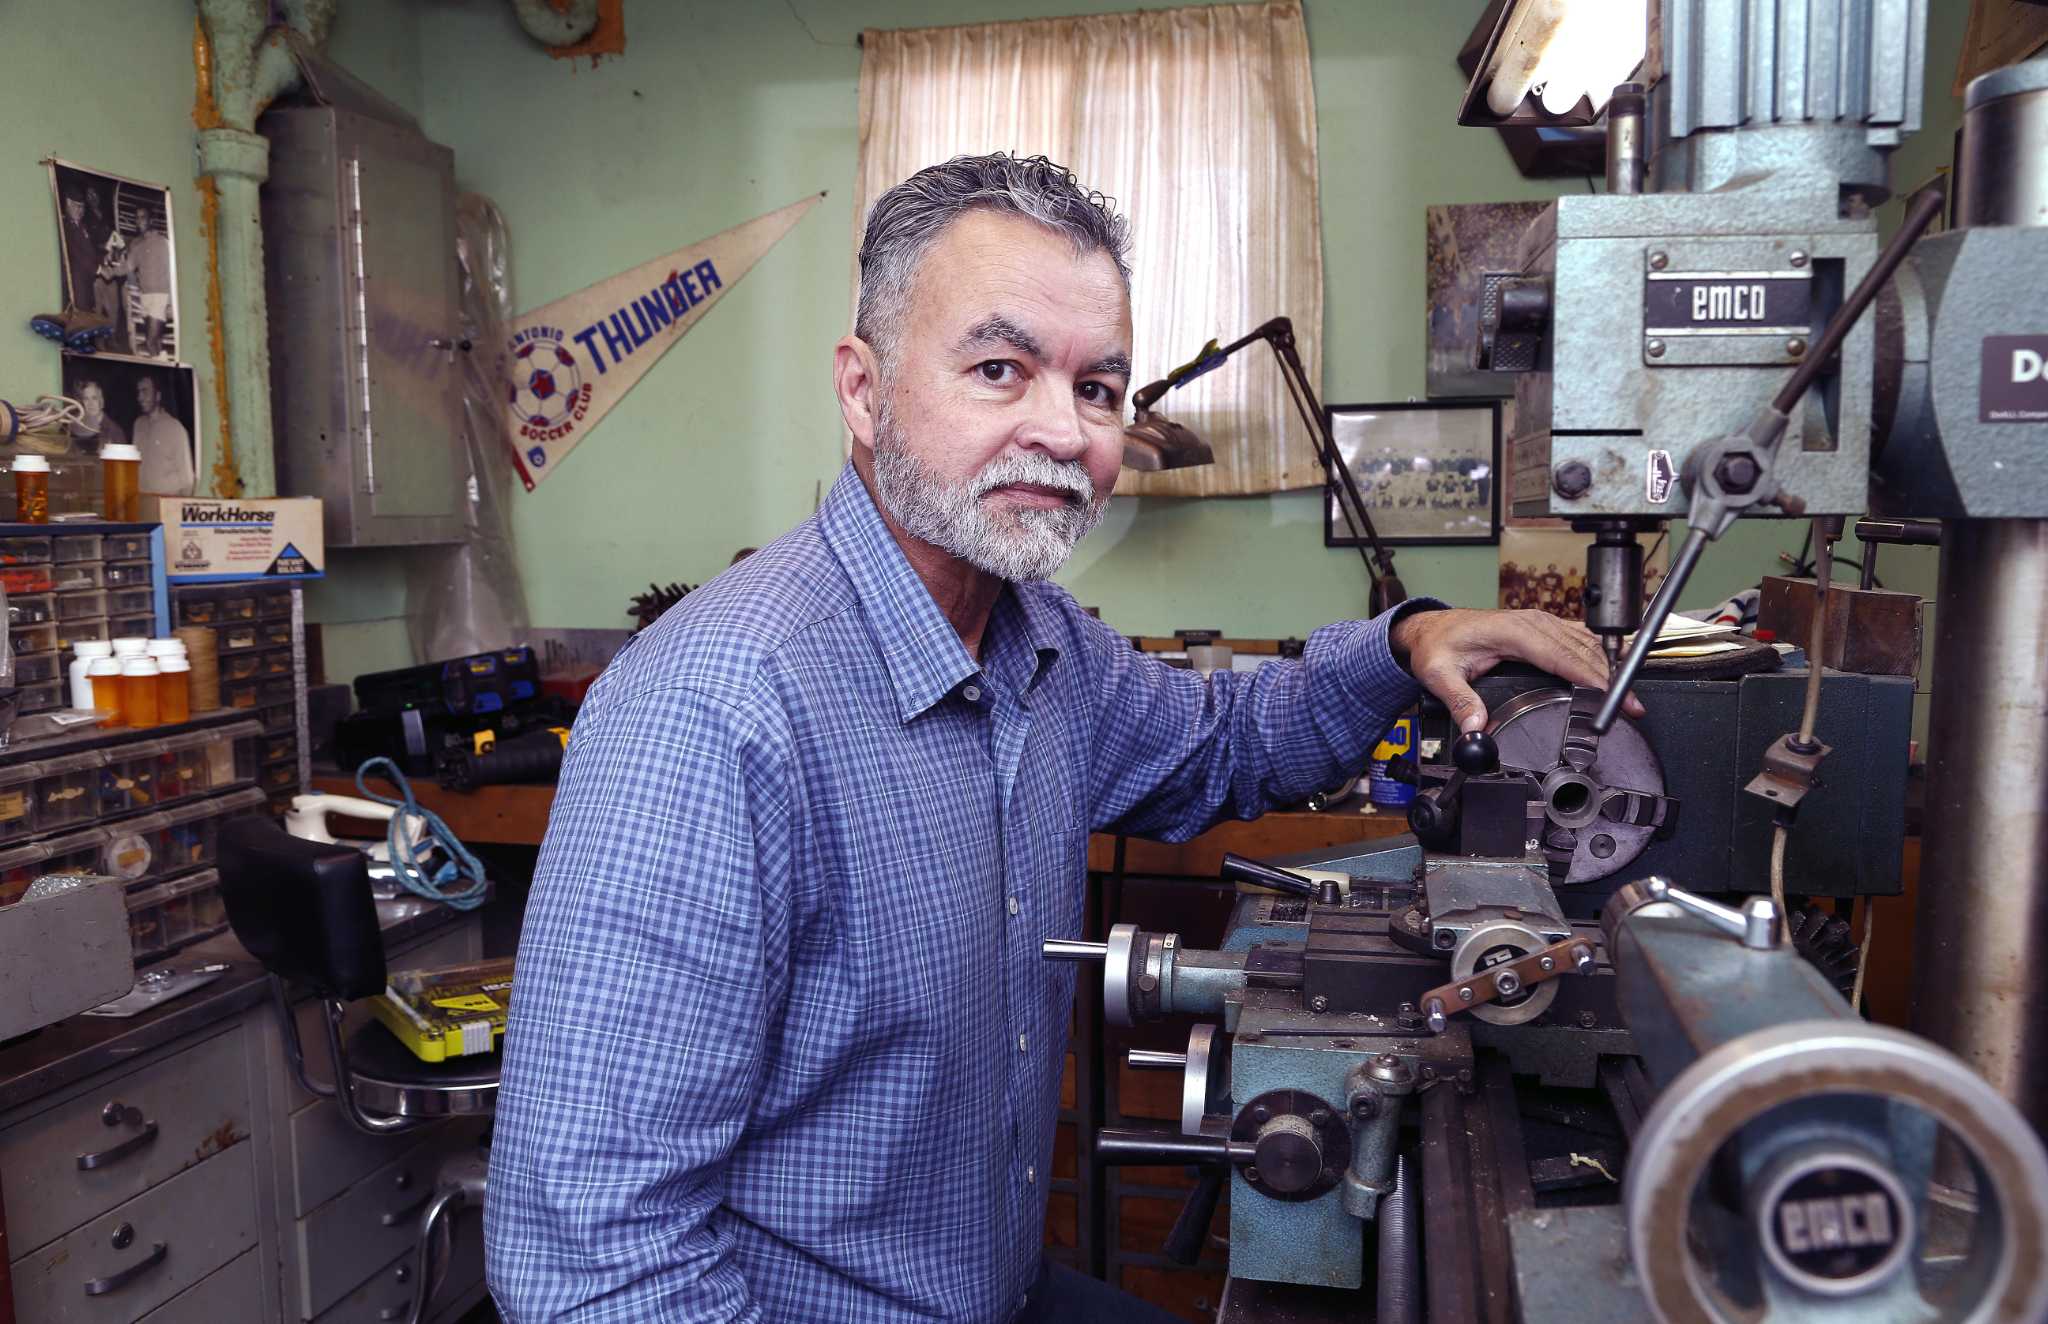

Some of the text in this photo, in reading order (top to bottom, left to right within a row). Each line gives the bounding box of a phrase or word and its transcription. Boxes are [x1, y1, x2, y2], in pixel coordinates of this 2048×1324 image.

[573, 258, 722, 375] THUNDER
[1692, 285, 1765, 321] emco
[520, 382, 592, 442] SOCCER CLUB
[181, 506, 275, 522] WorkHorse
